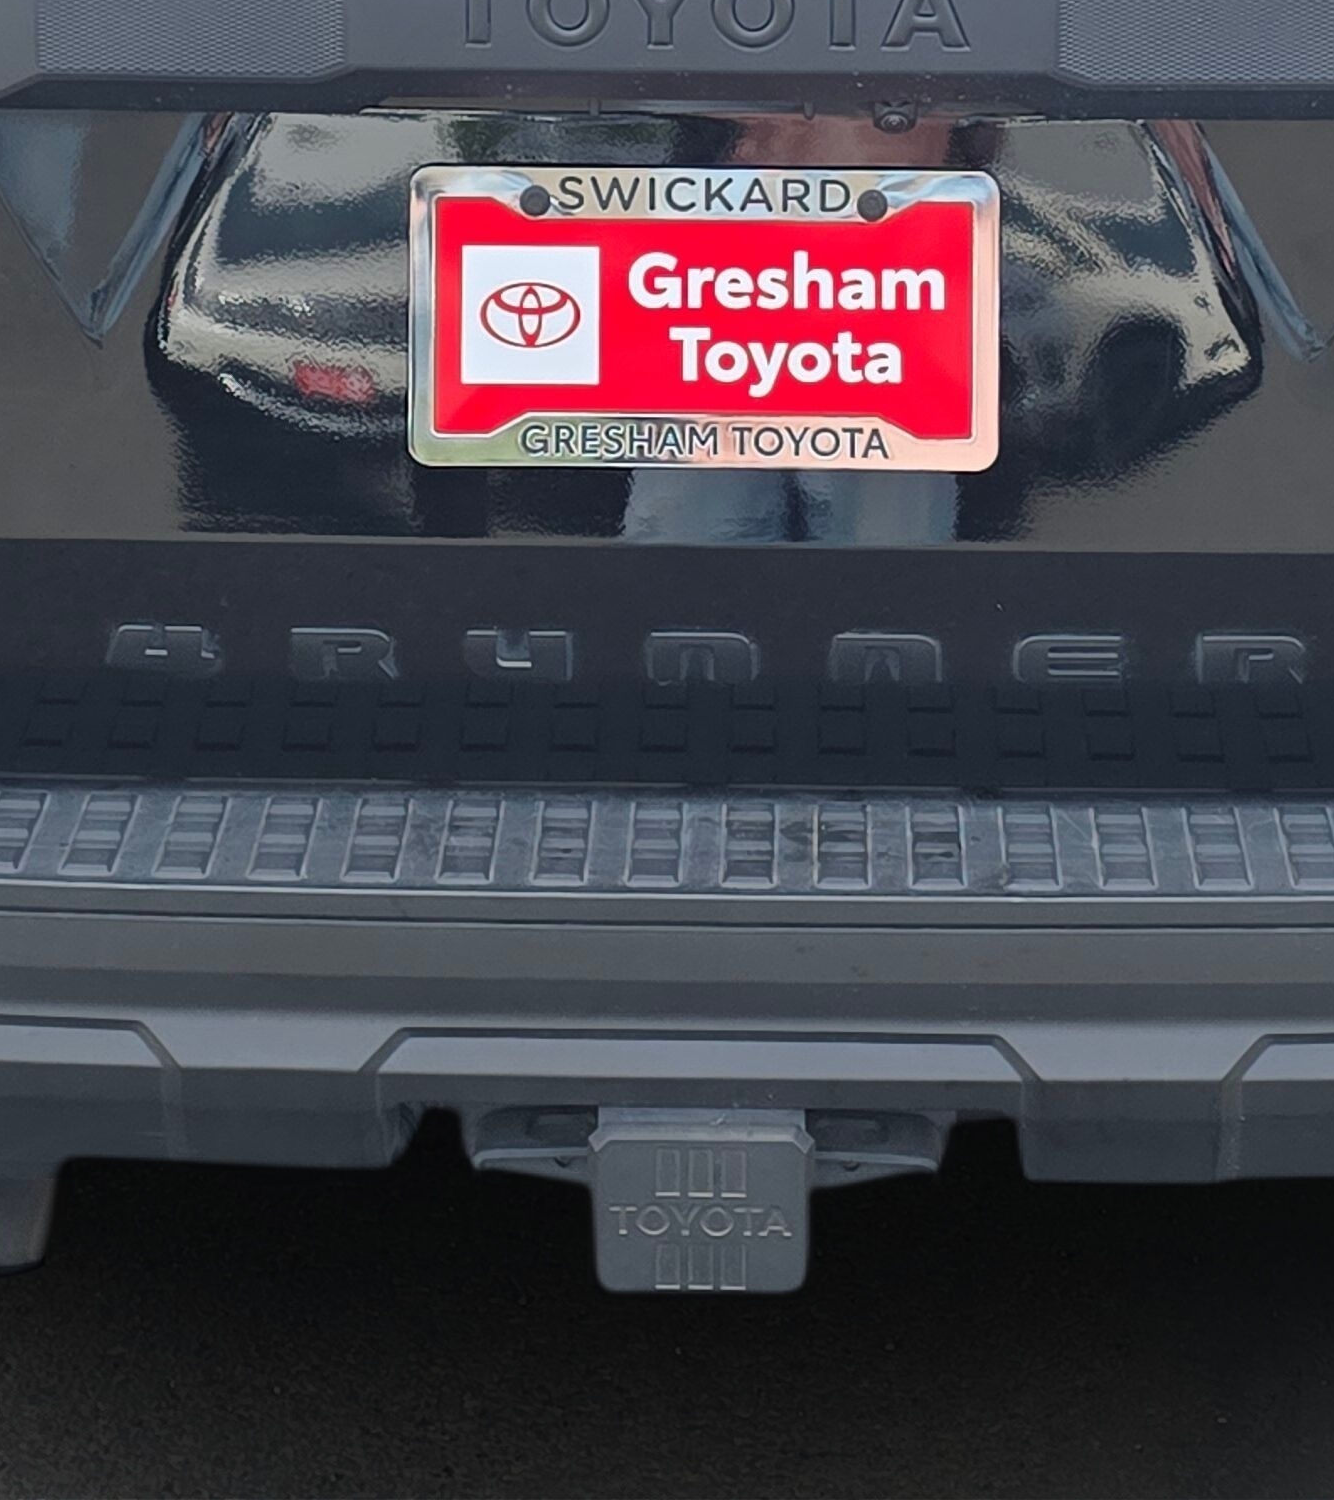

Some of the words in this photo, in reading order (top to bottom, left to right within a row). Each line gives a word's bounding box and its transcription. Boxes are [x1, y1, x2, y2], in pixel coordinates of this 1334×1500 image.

[557, 175, 851, 214] SWICKARD
[627, 250, 945, 311] Gresham
[668, 326, 903, 397] Toyota
[519, 423, 719, 459] GRESHAM
[732, 425, 889, 460] TOYOTA
[608, 1204, 793, 1238] TOYOTA
